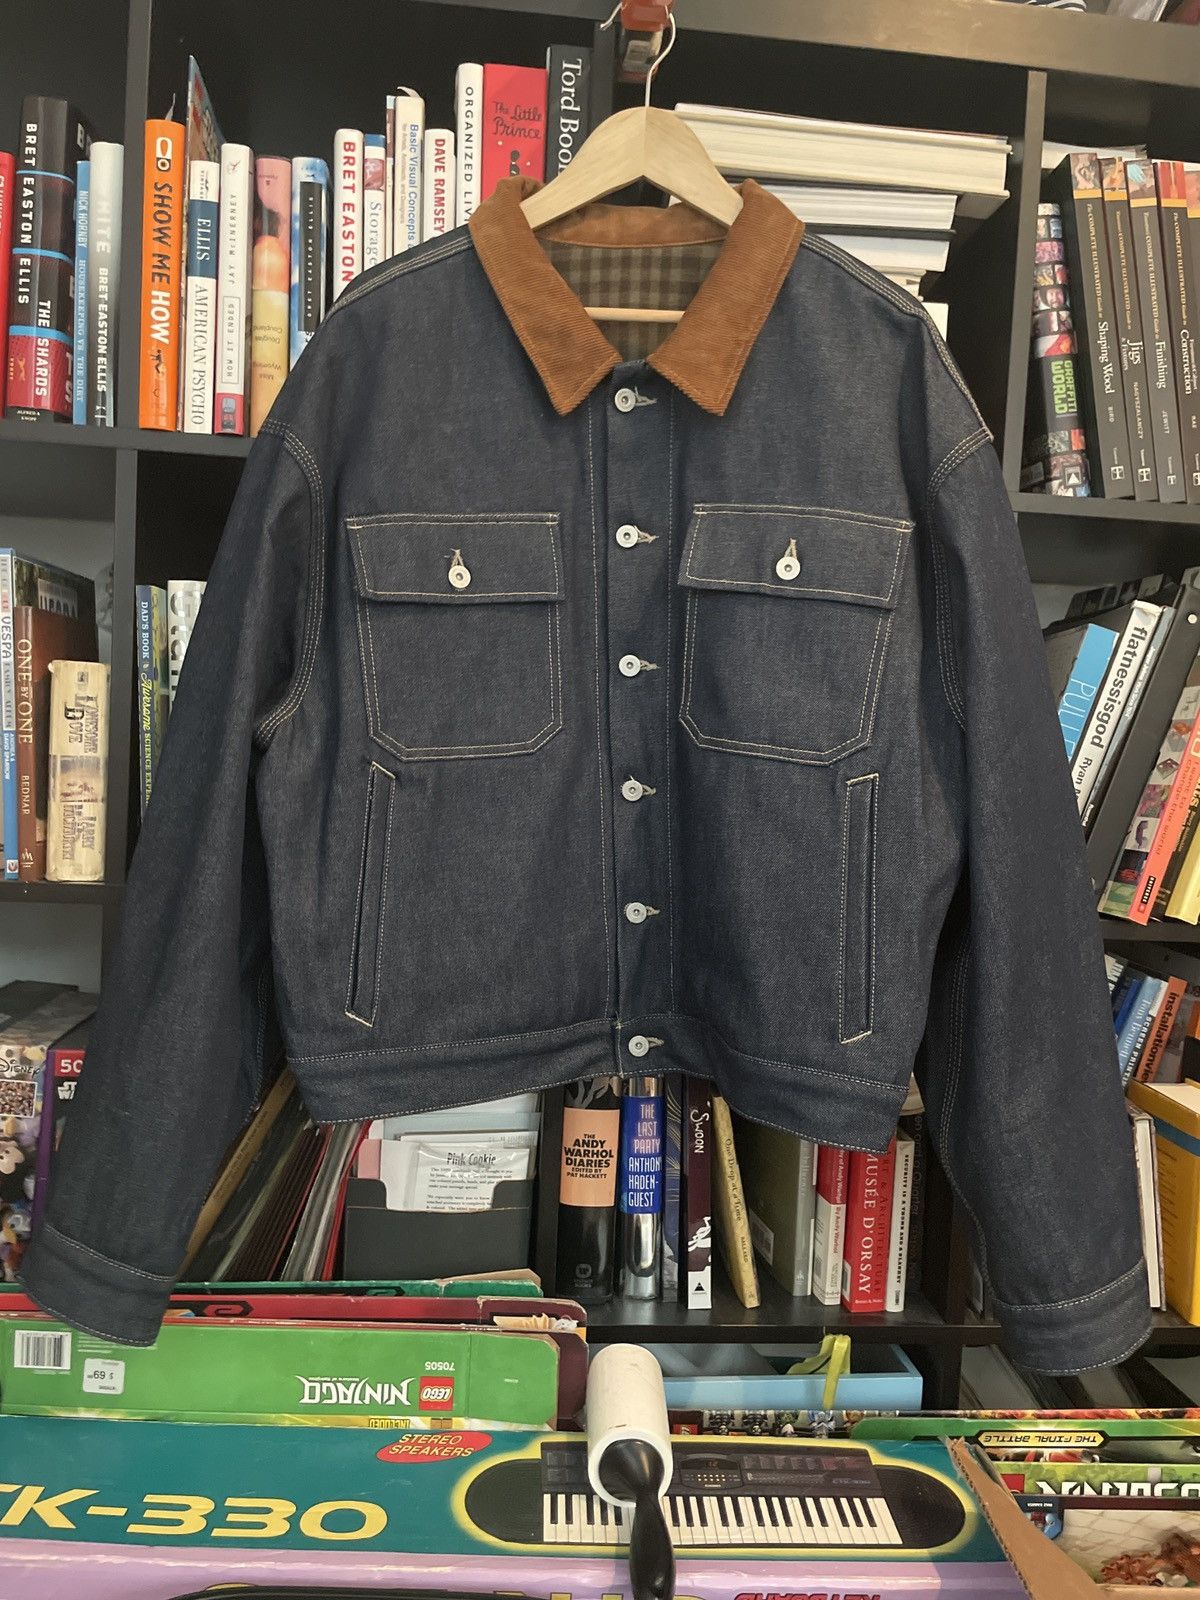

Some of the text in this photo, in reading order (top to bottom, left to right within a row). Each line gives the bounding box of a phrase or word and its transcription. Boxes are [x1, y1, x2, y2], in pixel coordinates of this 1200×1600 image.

[492, 100, 542, 121] The Little
[493, 116, 541, 139] Prince
[557, 58, 582, 177] Tord Boo
[463, 86, 474, 183] ORGANIZED
[407, 124, 419, 241] Basic Visual Concepts
[433, 138, 446, 233] DAVE RAMSEY
[18, 123, 38, 305] BRET EASTON ELLIS
[78, 190, 89, 215] NICK
[341, 141, 356, 283] BRET EASTON
[77, 215, 88, 248] HORNBY
[196, 218, 212, 261] ELLIS
[366, 201, 383, 265] Storage
[1088, 213, 1097, 250] COMPLETE
[150, 182, 173, 345] SHOW ME HOW
[228, 265, 238, 285] JAY
[77, 259, 86, 336] HOUSEKEEPING
[98, 267, 108, 301] BRET
[1146, 235, 1155, 272] COMPLETE
[1155, 341, 1168, 389] Finishing
[35, 300, 51, 397] THE SHARDS
[98, 304, 108, 357] EASTON
[227, 341, 234, 351] IT
[1097, 321, 1110, 363] Shaping
[77, 356, 85, 376] THE
[191, 284, 208, 425] AMERICAN PSYCHO
[1127, 340, 1144, 365] Jigs
[1180, 329, 1192, 395] Construction
[76, 377, 85, 402] DIRT
[97, 357, 107, 393] ELLIS
[1051, 361, 1068, 414] WORLD
[1064, 360, 1077, 413] GRAFFITI
[1103, 362, 1115, 394] Wood
[1, 616, 12, 659] VESPA
[17, 638, 33, 744] ONE BY ONE
[140, 601, 153, 769] DAD'S BOOK Awesome SCIENCE
[64, 702, 85, 744] DOVE
[1071, 626, 1148, 785] flatnessisgod Ryan
[1135, 1013, 1152, 1050] SCREEN
[638, 1121, 658, 1136] LAST
[641, 1104, 655, 1119] THE
[446, 1152, 497, 1167] Pink Cookie
[564, 1147, 614, 1159] WARHOL
[573, 1138, 606, 1149] ANDY
[634, 1139, 661, 1153] PARTY
[565, 1156, 611, 1168] DIARIES
[628, 1157, 663, 1173] ANTHONY
[628, 1174, 659, 1190] HADEN-
[628, 1192, 654, 1207] GUEST
[858, 1217, 876, 1295] D'ORSAY
[874, 1198, 887, 1294] ARCHITECTURE
[424, 1361, 456, 1372] 70505
[294, 1375, 453, 1406] LEGO NINJAGO
[389, 1445, 476, 1458] SPEAKERS
[399, 1433, 463, 1445] STEREO
[983, 1435, 1097, 1443] THE FINAL BATTLE
